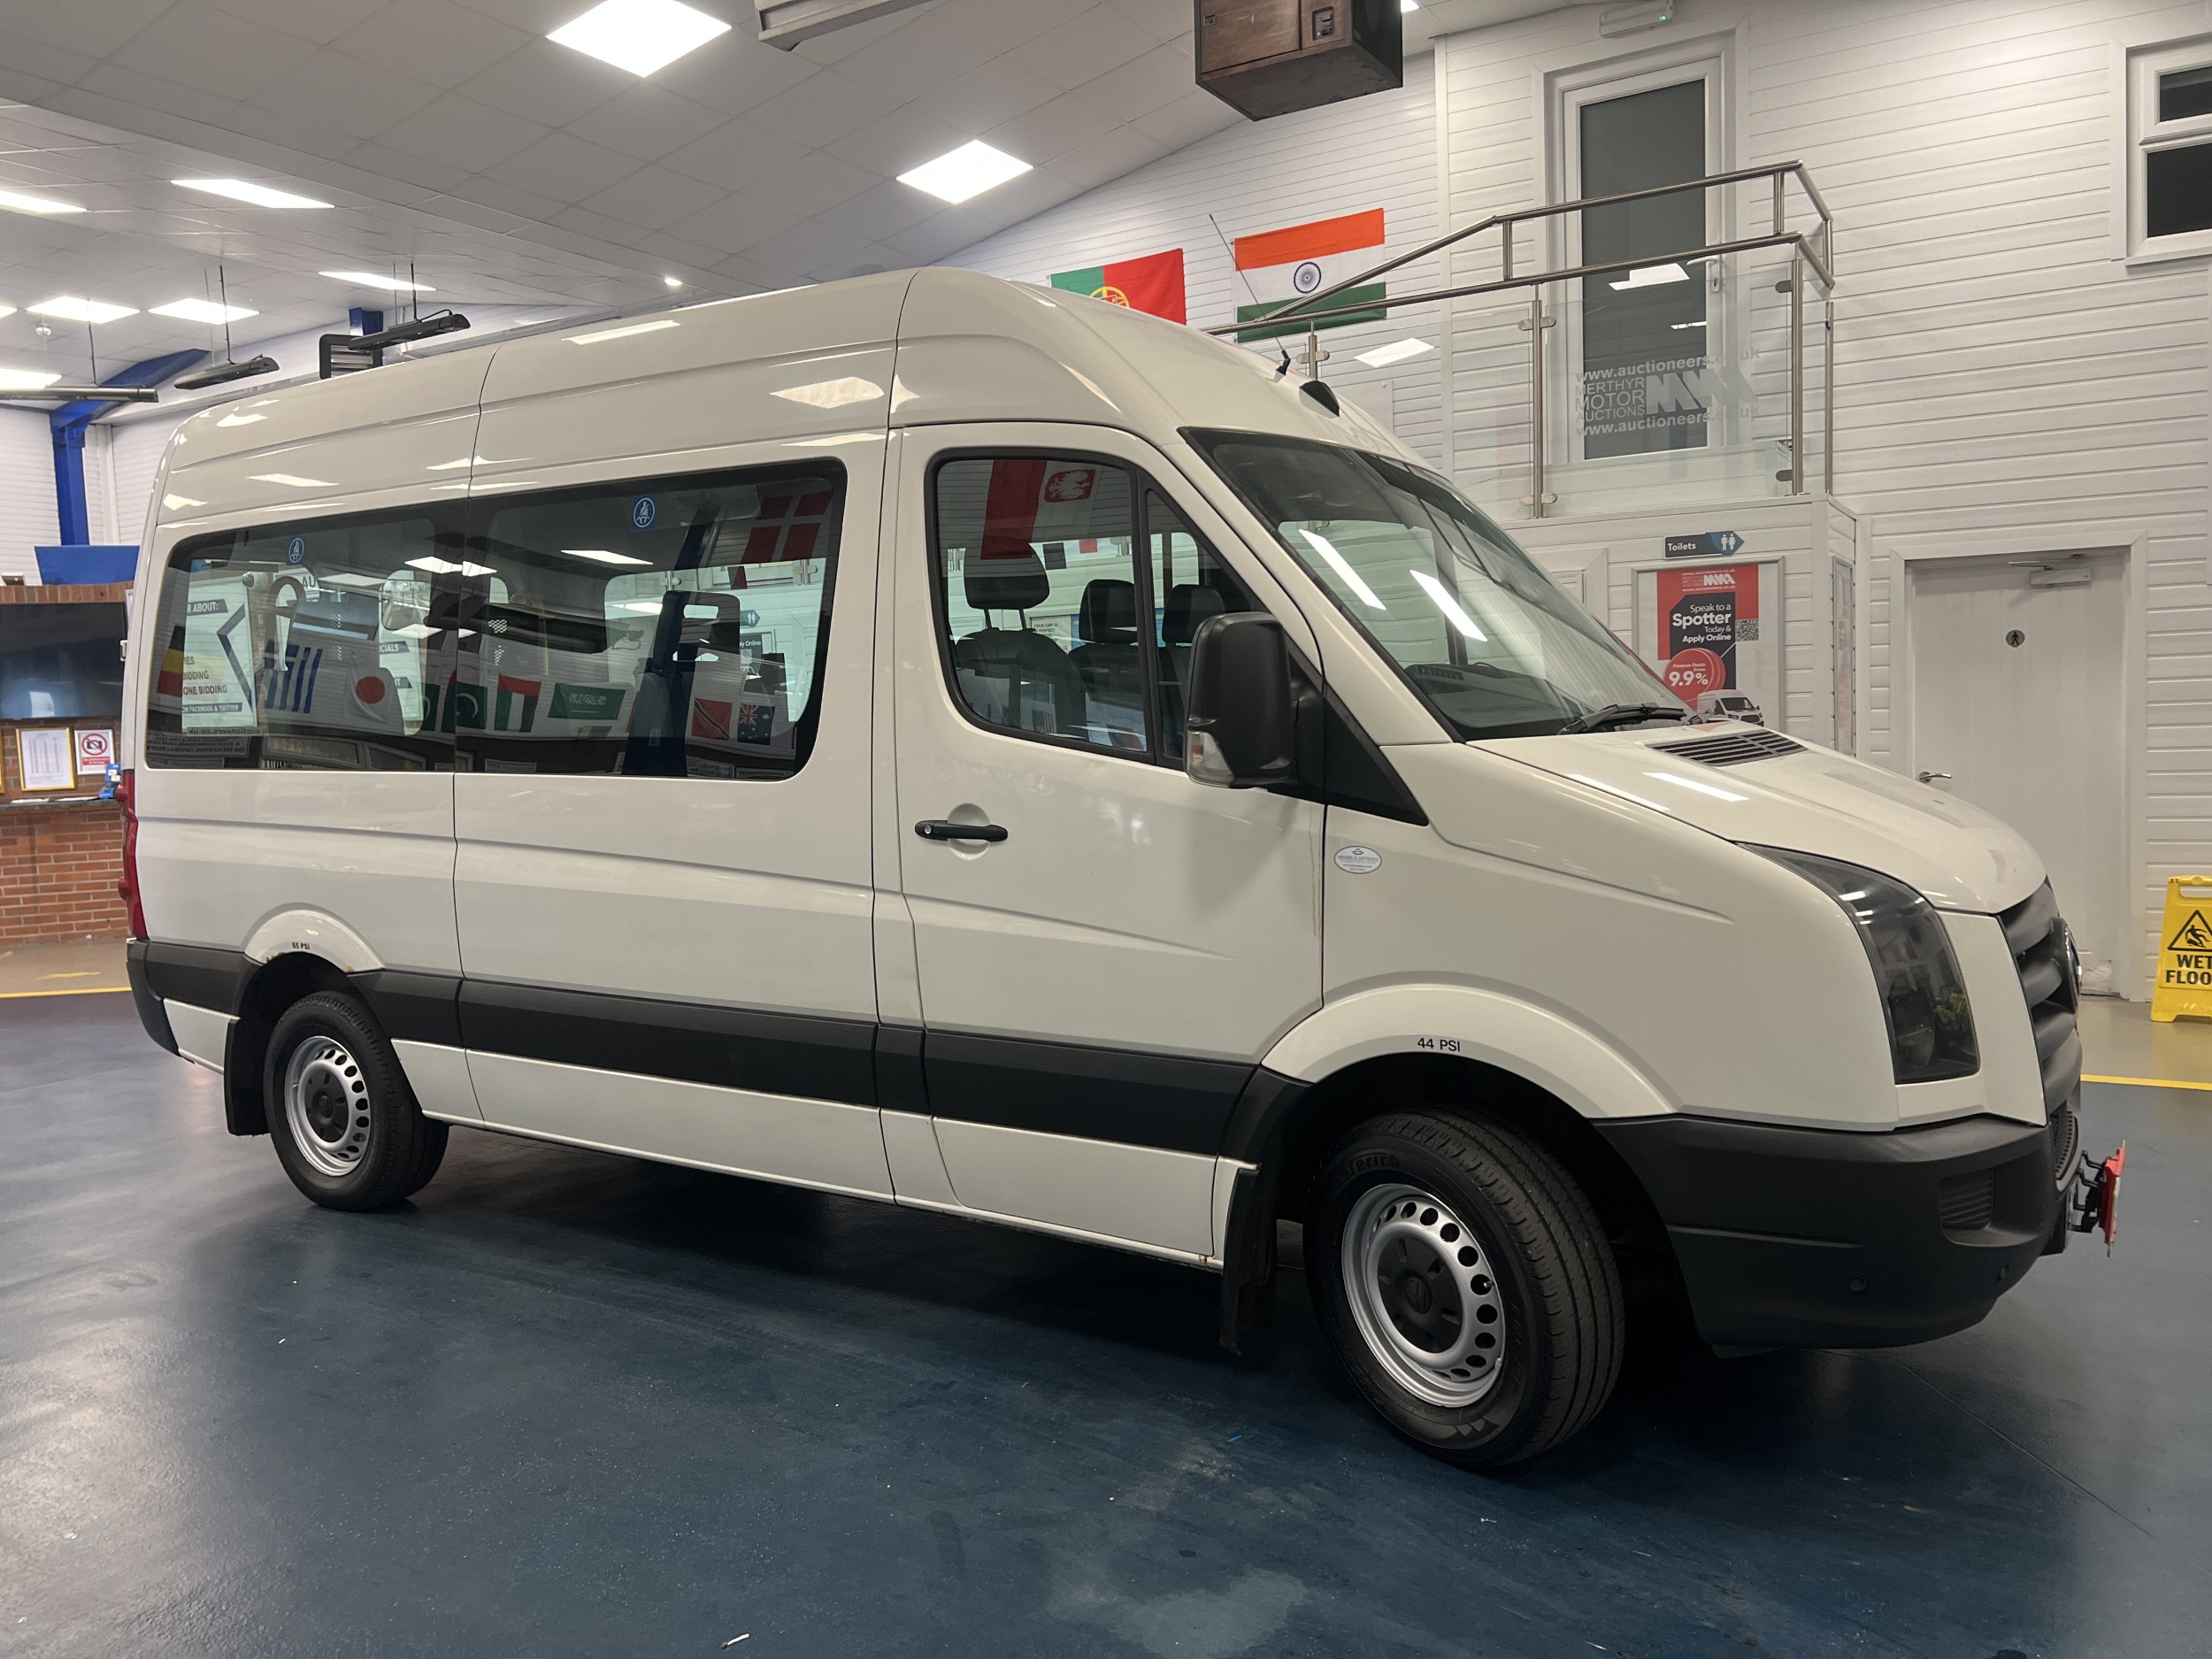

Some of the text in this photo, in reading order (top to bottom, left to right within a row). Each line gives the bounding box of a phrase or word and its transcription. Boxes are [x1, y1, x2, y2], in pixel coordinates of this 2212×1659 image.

[1576, 346, 1761, 382] www.auctioneers.cuk
[1575, 376, 1646, 397] MERTHYR
[1575, 389, 1646, 412] MOTOR
[1576, 404, 1646, 424] AUCTIONS
[1576, 403, 1760, 436] www.auctioneers.cuk
[1667, 542, 1696, 551] Toilets
[193, 602, 219, 612] ABOUT:
[1690, 603, 1715, 614] Speak
[1672, 612, 1732, 629] Spotter
[1682, 634, 1705, 643] Apply
[183, 671, 209, 680] BIDDING
[1669, 671, 1709, 687] 9.9%
[199, 685, 227, 695] BIDDING
[2177, 954, 2212, 969] WET
[1417, 1037, 1460, 1052] 44 PSI
